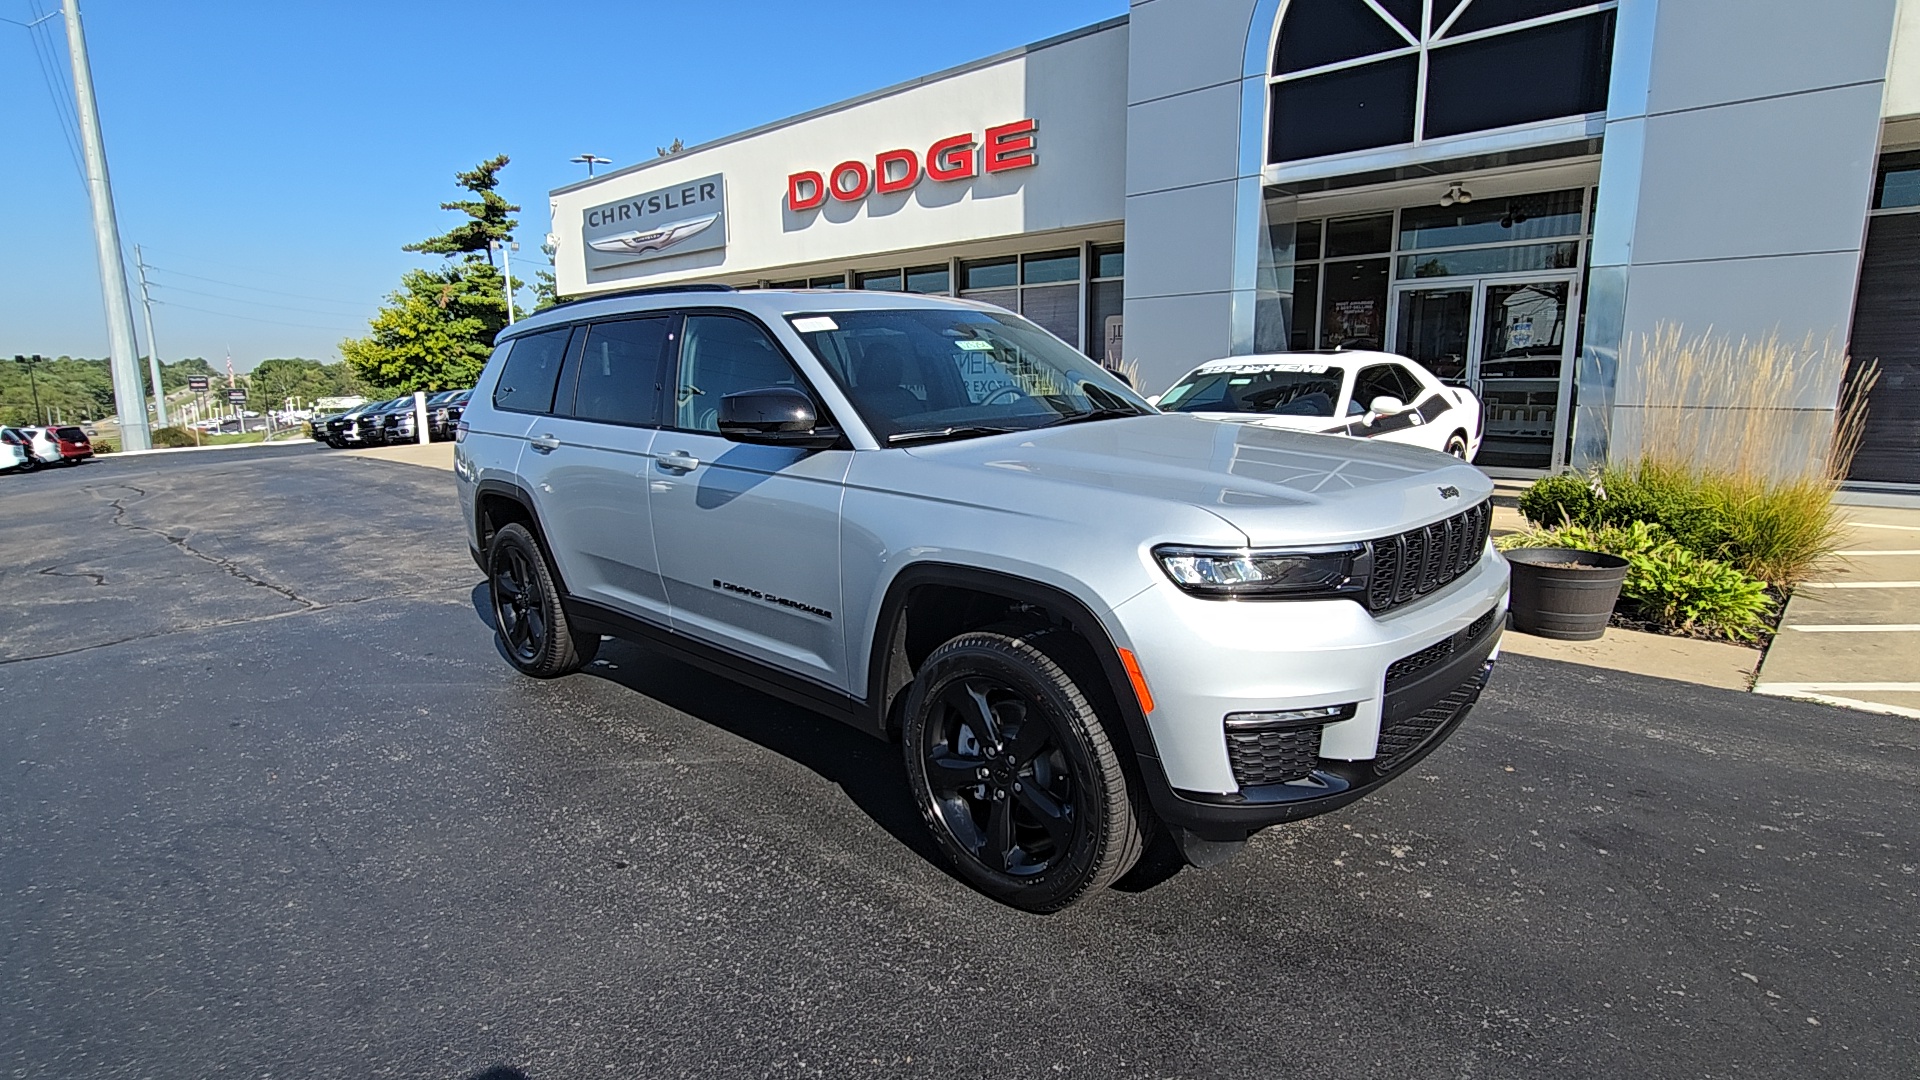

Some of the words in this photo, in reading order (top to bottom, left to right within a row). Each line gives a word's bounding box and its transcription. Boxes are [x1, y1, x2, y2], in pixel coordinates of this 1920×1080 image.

[788, 118, 1037, 211] DODGE
[588, 182, 716, 227] CHRYSLER
[723, 582, 763, 599] GRAND
[765, 594, 833, 619] CHEROKEE
